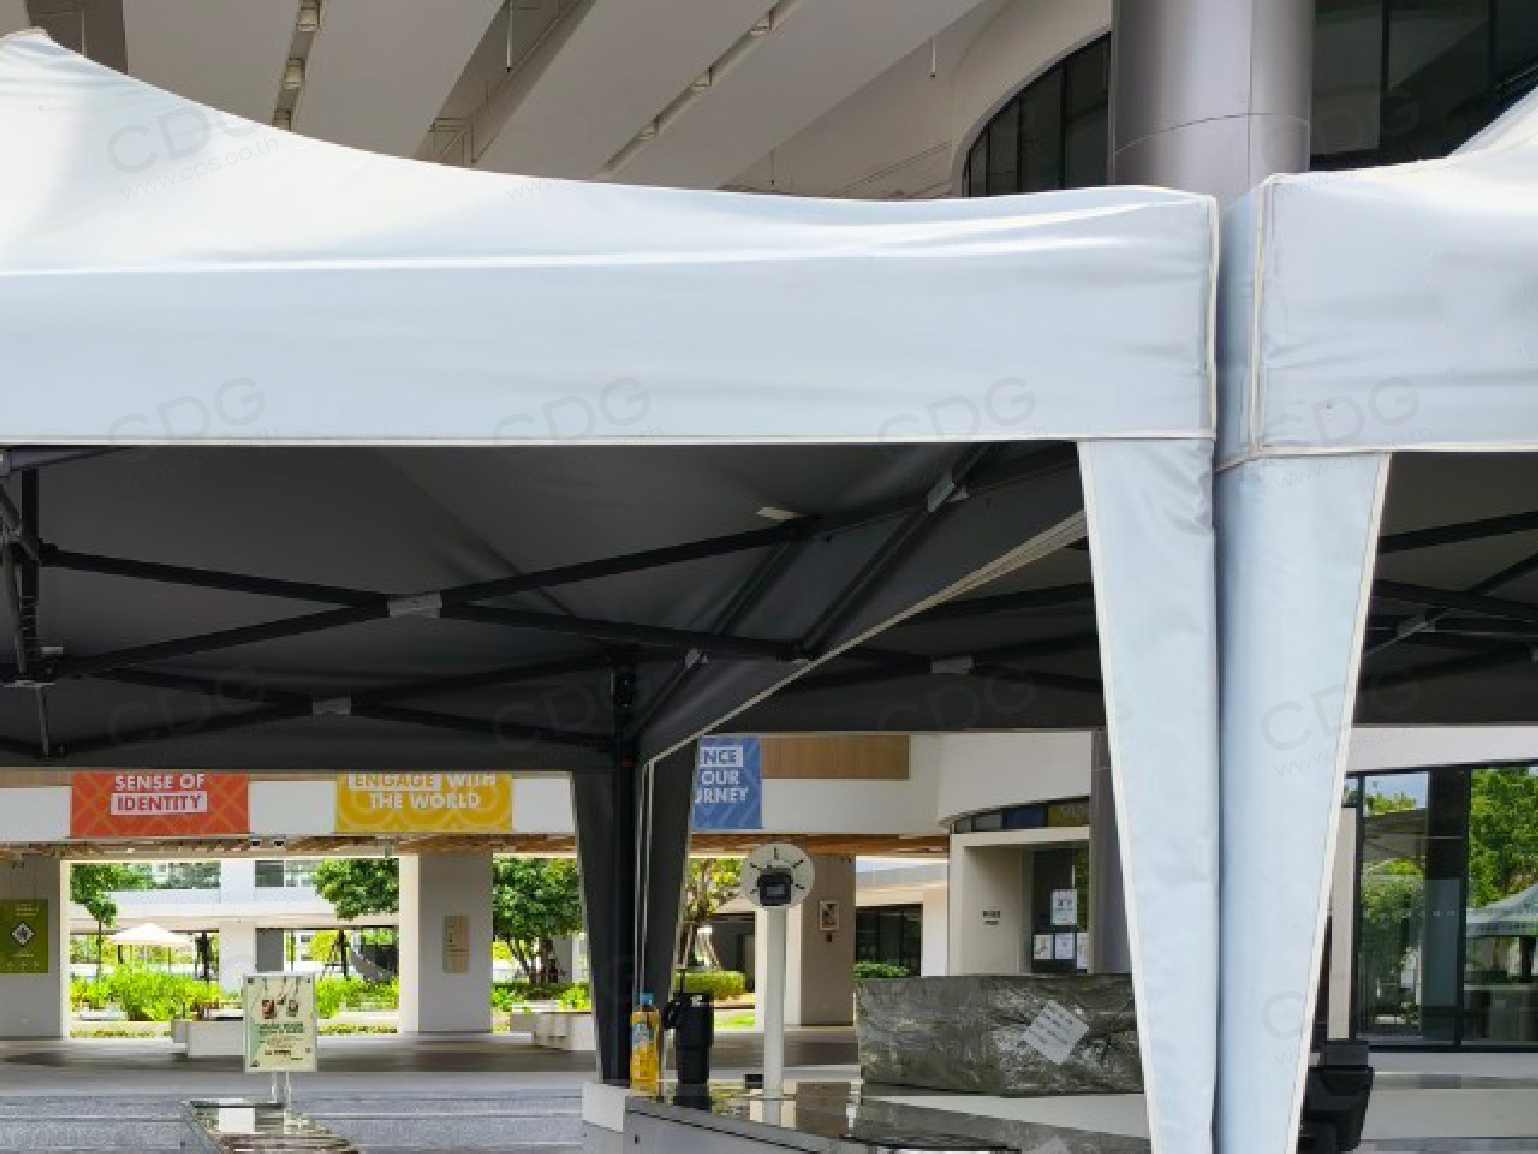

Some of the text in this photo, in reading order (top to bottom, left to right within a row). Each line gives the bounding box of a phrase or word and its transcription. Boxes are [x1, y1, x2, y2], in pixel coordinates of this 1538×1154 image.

[703, 750, 737, 765] NCE
[115, 774, 205, 791] SENSE OF
[117, 795, 202, 811] IDENTITY
[370, 792, 481, 809] THE WORLD
